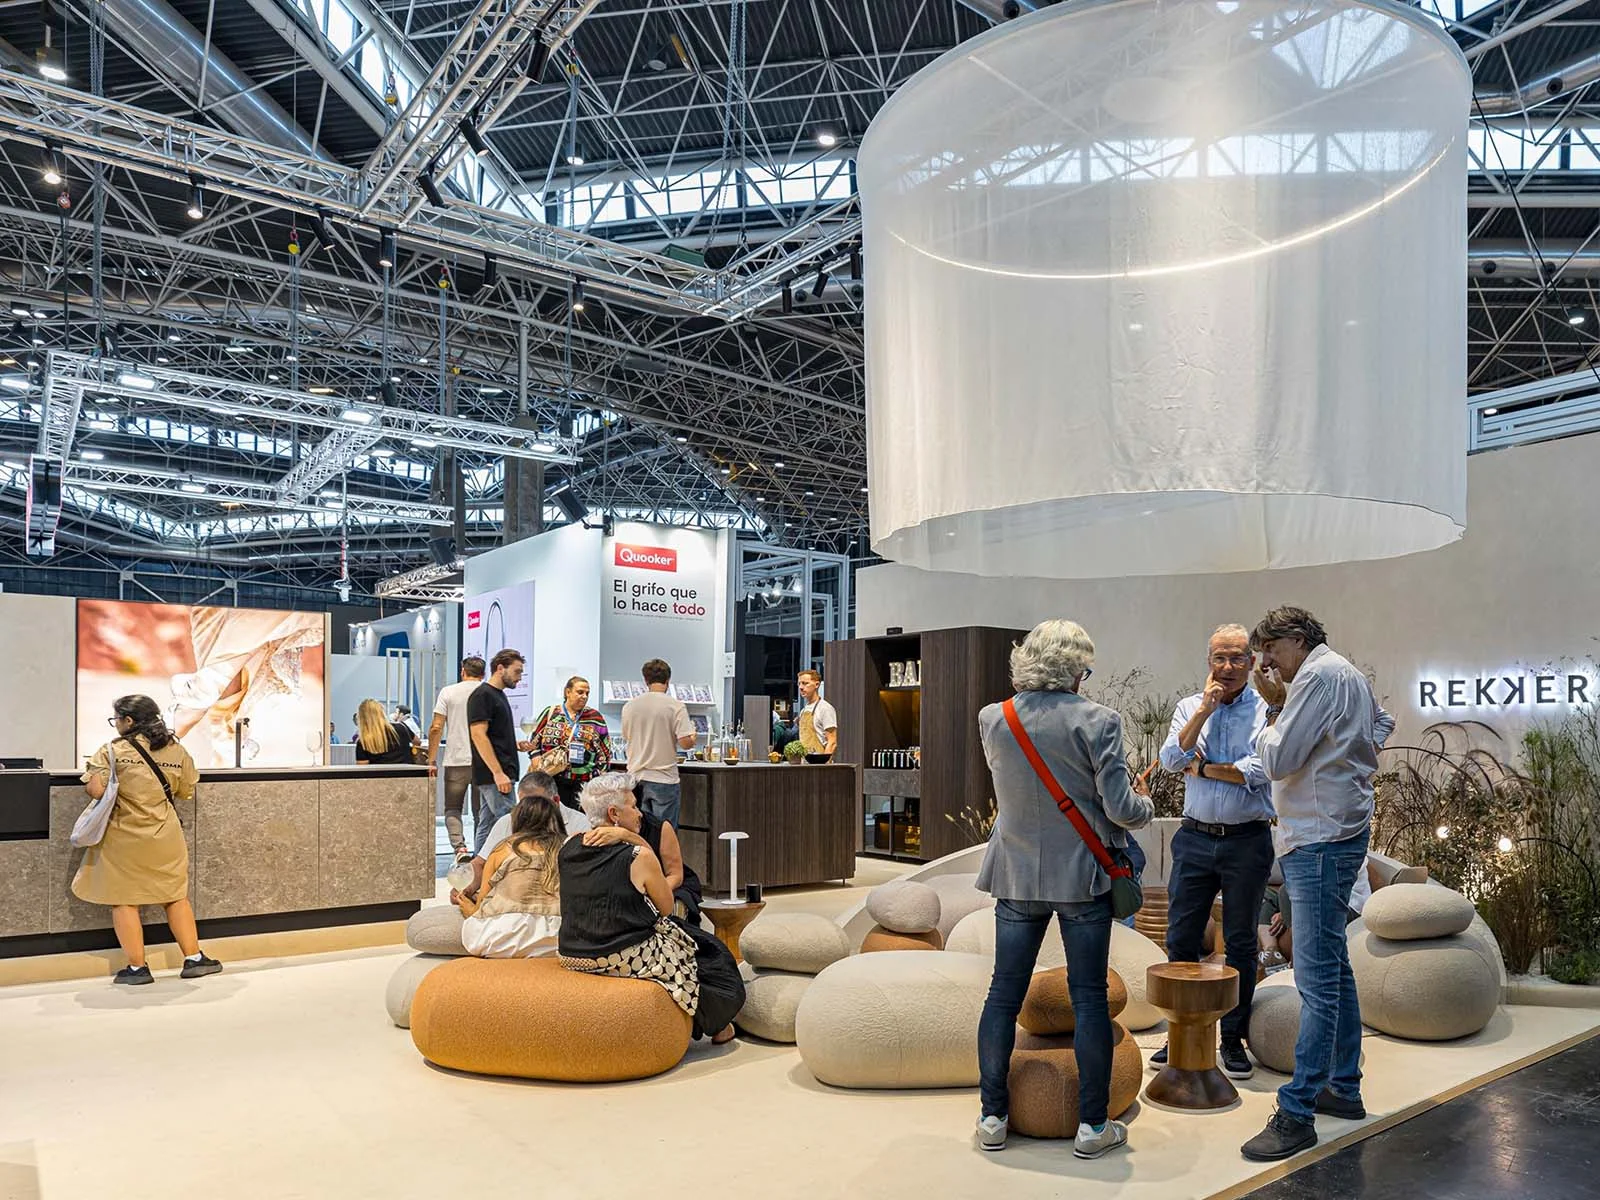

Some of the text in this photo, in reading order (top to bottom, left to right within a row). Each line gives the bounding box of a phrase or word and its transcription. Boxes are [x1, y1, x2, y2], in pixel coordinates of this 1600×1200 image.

[620, 548, 672, 565] Quooker
[614, 579, 697, 600] El grifo que
[613, 596, 706, 616] lo hace todo
[1419, 674, 1589, 707] REKKER
